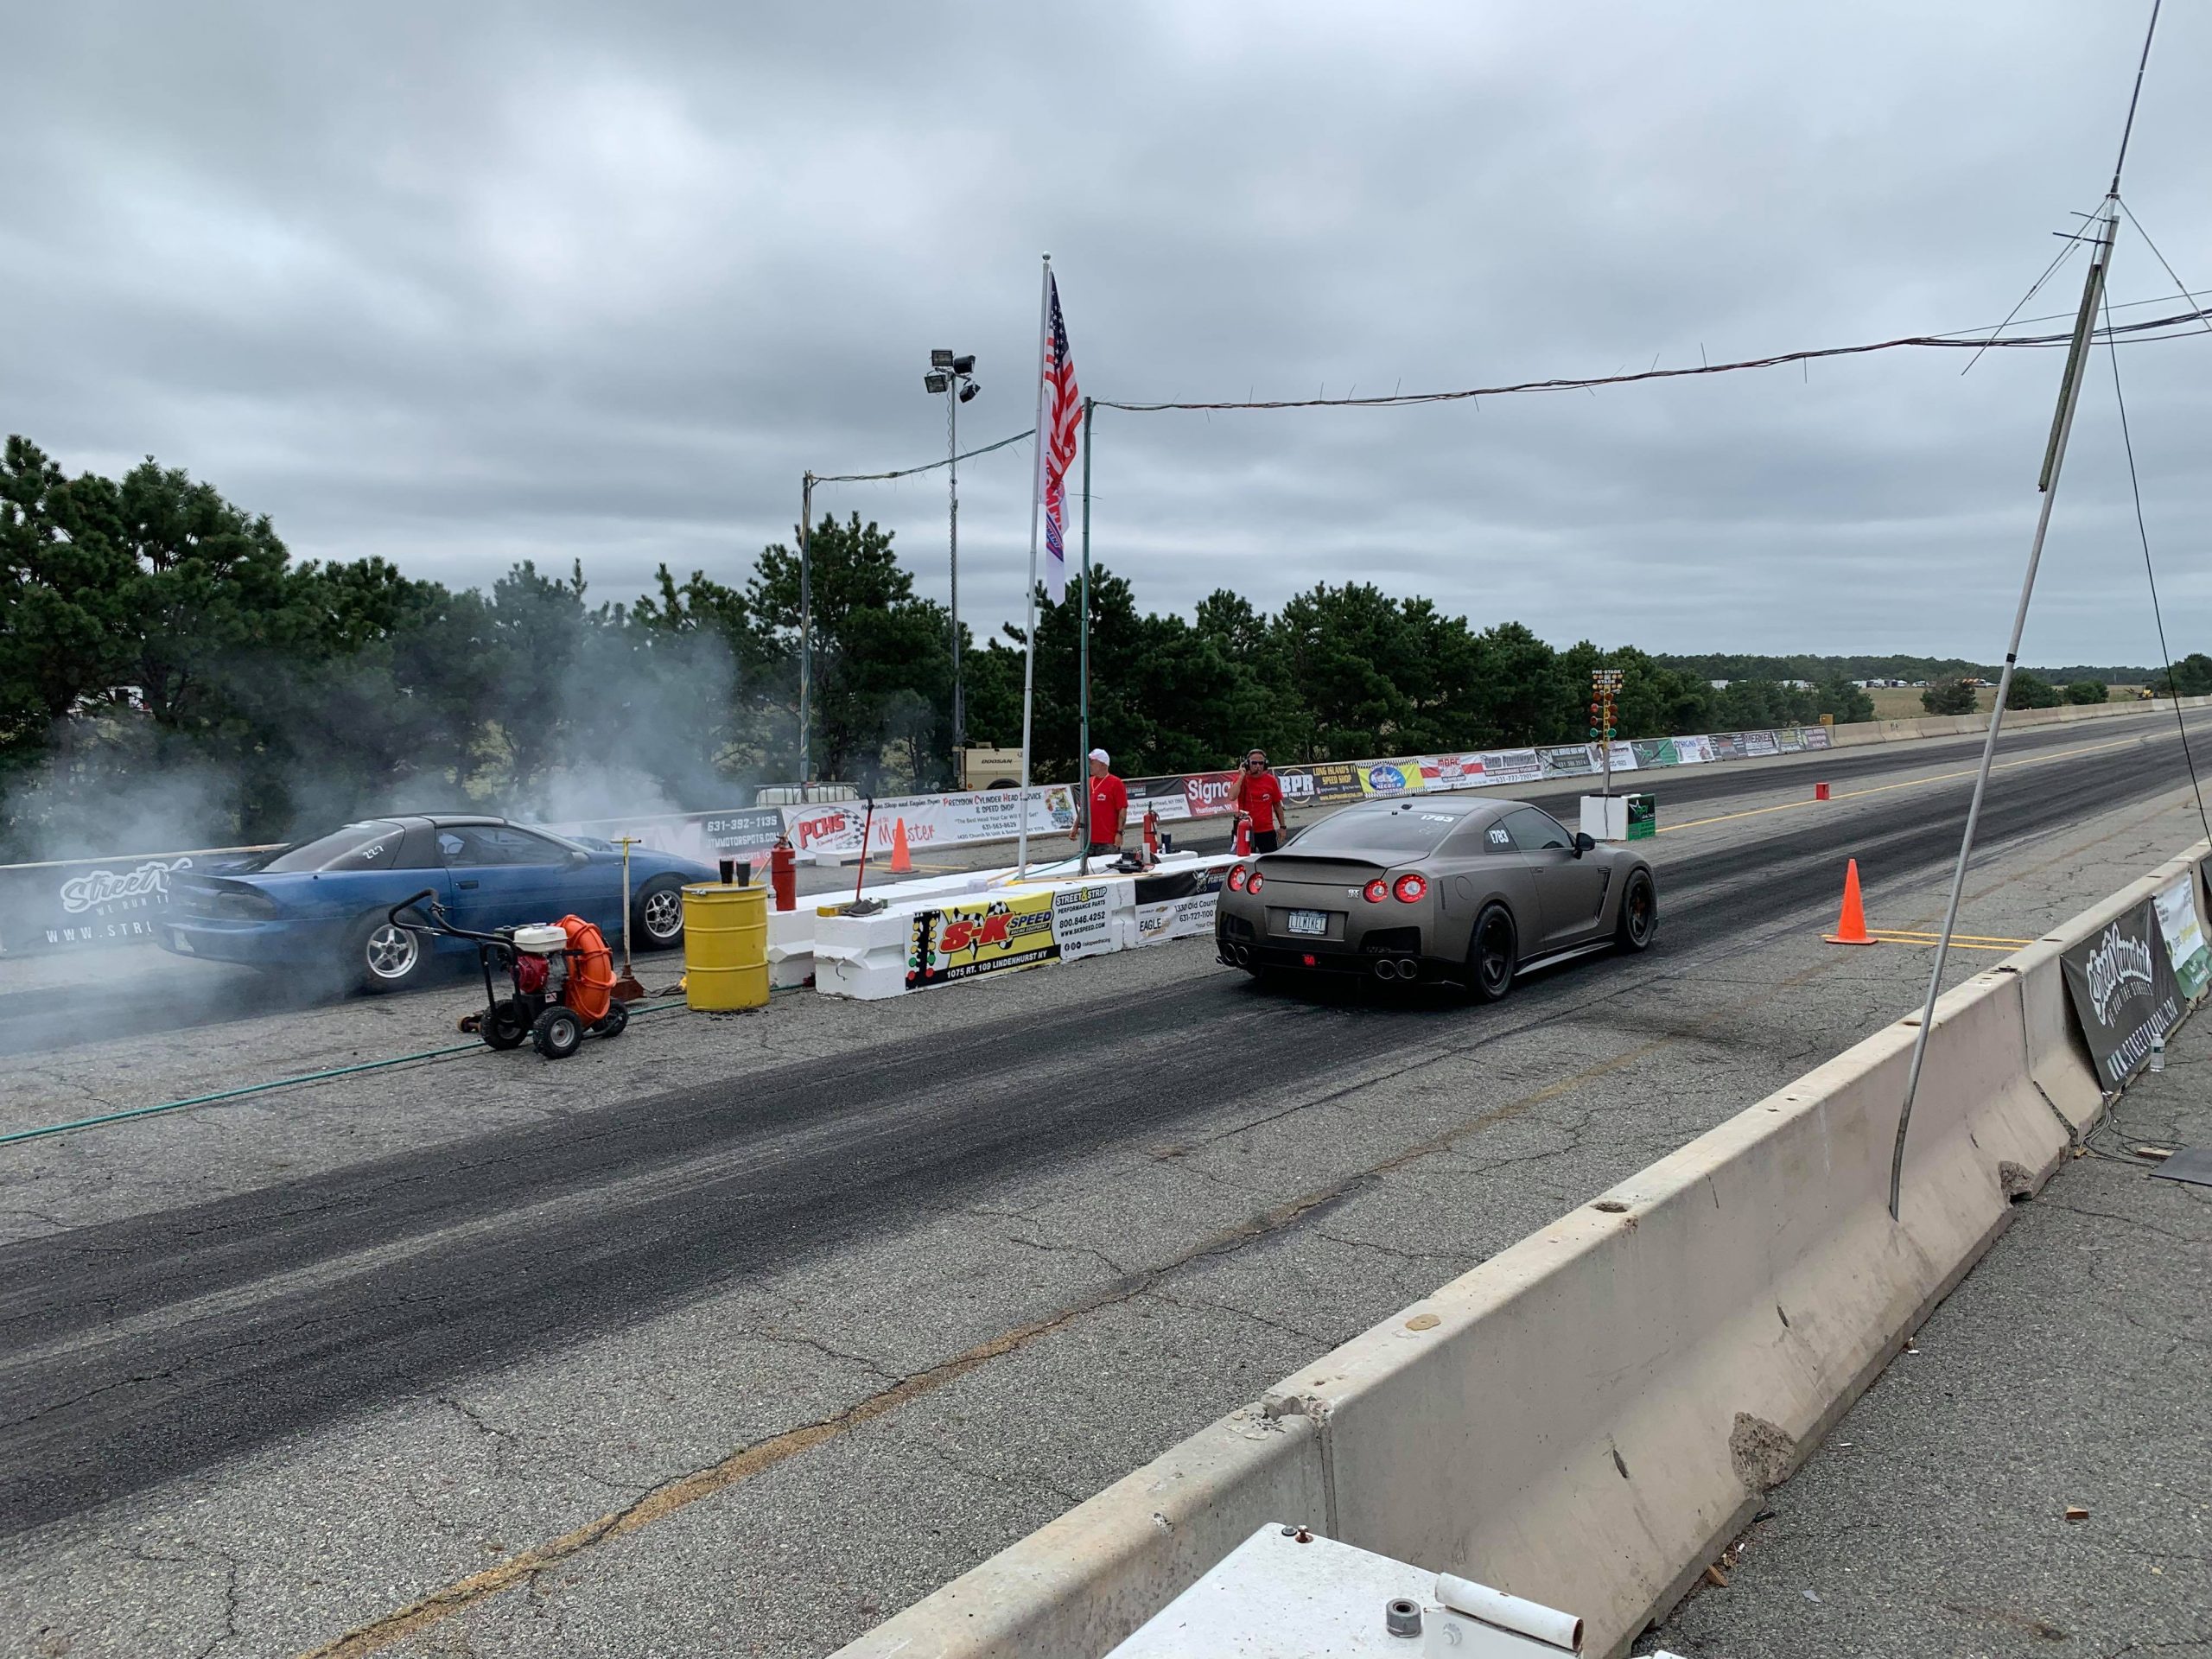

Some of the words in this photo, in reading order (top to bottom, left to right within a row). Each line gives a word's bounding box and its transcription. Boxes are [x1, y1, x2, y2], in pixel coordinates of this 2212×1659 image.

[1313, 767, 1327, 777] LONG
[1327, 765, 1350, 775] ISLAND'S
[1279, 774, 1313, 793] BPR
[1322, 776, 1338, 785] SPEED
[1338, 775, 1352, 784] SHOP
[943, 797, 974, 807] PRECISION
[974, 794, 1002, 804] CYLINDER
[1003, 793, 1019, 802] HEAD
[1020, 791, 1042, 801] SRVICE
[982, 804, 1000, 813] SPEED
[708, 816, 778, 831] 631-392-1135
[798, 813, 846, 850] PCHS
[879, 823, 935, 845] Mster
[1489, 830, 1510, 843] 1783
[363, 845, 384, 859] 227
[96, 904, 114, 916] WE
[123, 898, 147, 910] RUN
[1058, 902, 1091, 914] PERFORMANCE
[1174, 904, 1187, 912] 1330
[1199, 899, 1217, 908] Count
[1059, 911, 1106, 929] 800.846.4252
[1179, 910, 1214, 922] 631-727-1100
[939, 912, 1014, 954] S-K
[1009, 911, 1052, 929] SPEED
[1061, 922, 1105, 938] WWW.SKSPEED.COM
[1140, 918, 1161, 932] EAGLE
[947, 968, 965, 978] 1075
[965, 966, 977, 976] RT.
[978, 963, 991, 972] 109
[992, 952, 1037, 969] LINDENHURST
[1038, 950, 1047, 958] NY
[2120, 984, 2132, 1002] THE
